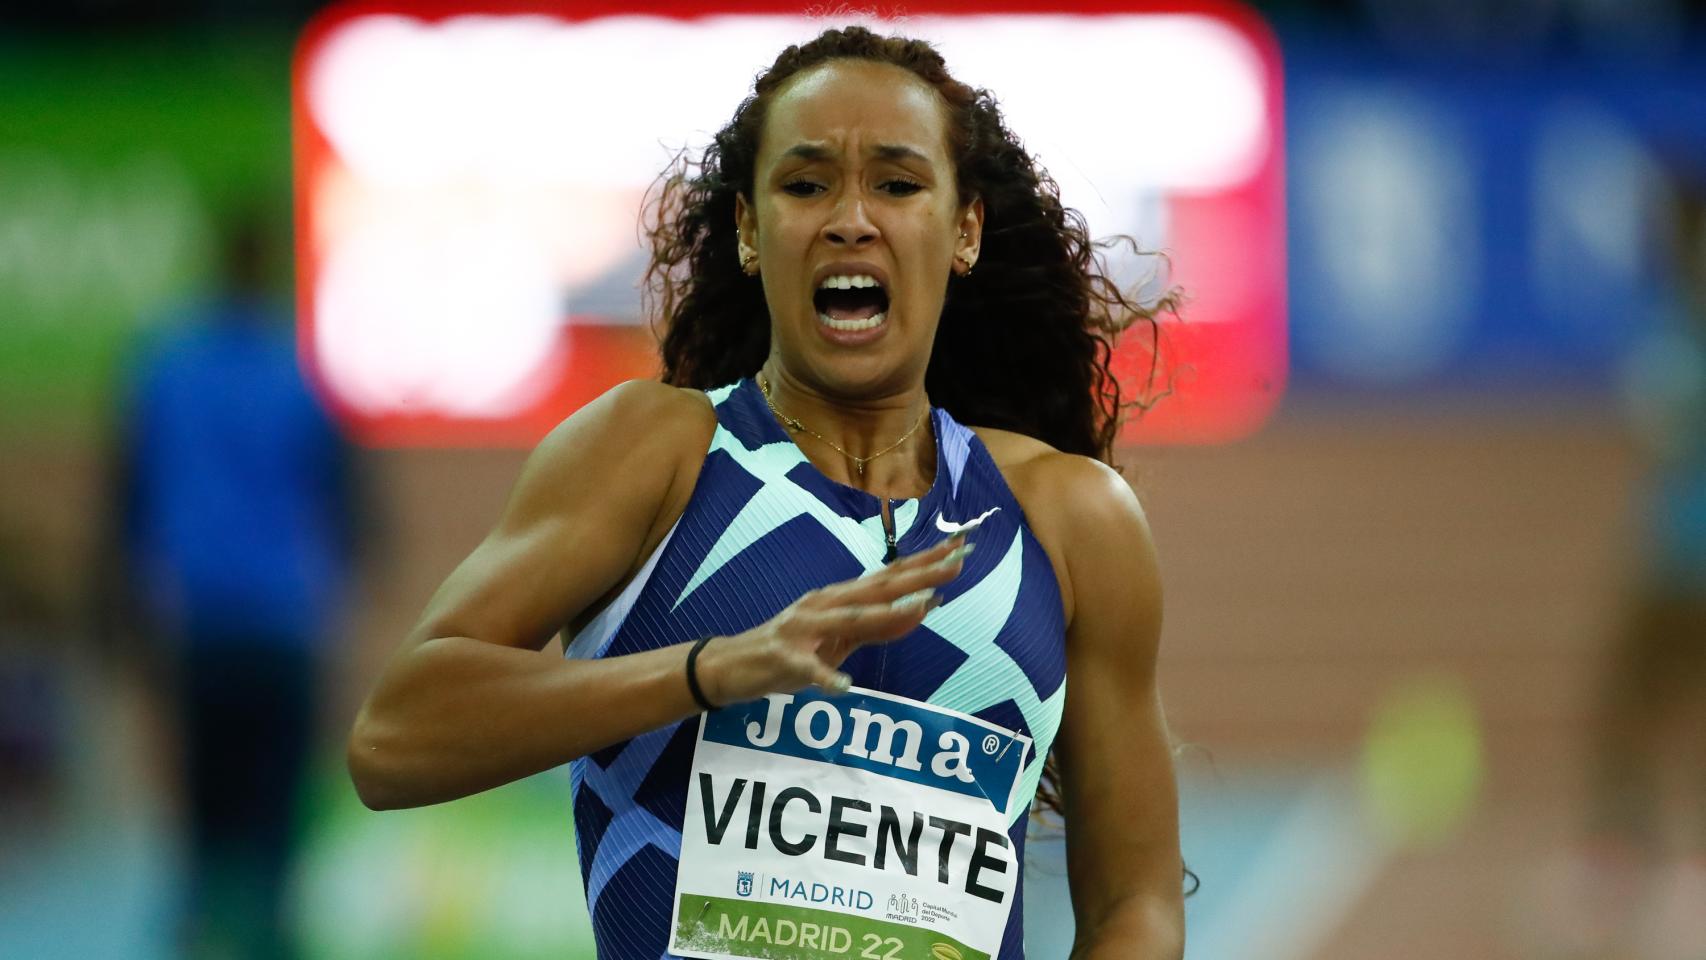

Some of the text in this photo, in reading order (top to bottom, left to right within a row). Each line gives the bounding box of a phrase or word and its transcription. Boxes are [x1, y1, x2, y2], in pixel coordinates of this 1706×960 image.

[698, 772, 1009, 904] VICENTE
[770, 877, 873, 911] MADRID
[922, 902, 941, 911] Capital
[886, 913, 917, 924] MADRID
[921, 915, 936, 923] 2022
[719, 913, 904, 960] MADRID 22
